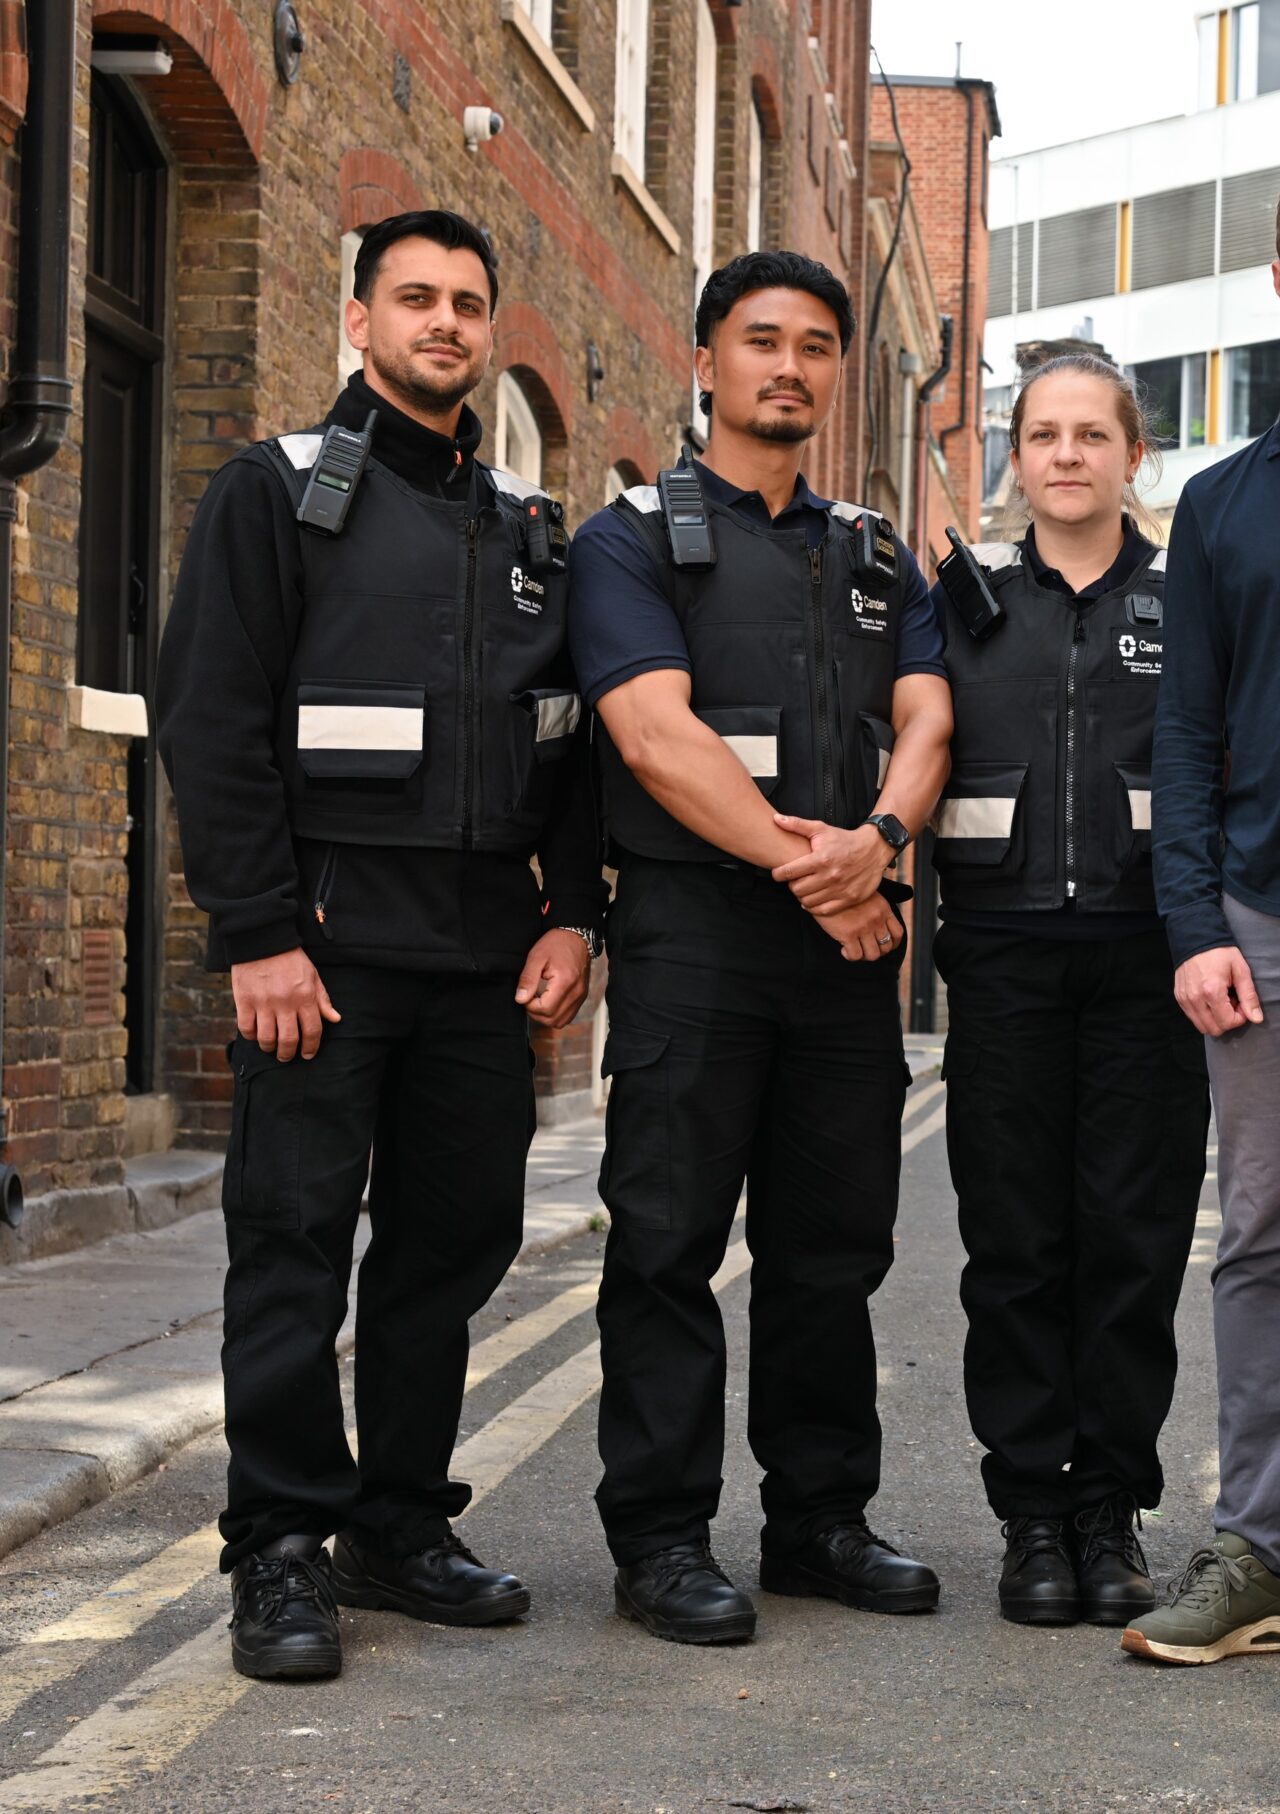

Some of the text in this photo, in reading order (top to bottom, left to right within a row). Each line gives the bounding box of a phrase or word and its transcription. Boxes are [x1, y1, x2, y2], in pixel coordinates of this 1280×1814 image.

[524, 575, 545, 595] Camden
[863, 595, 888, 611] Camden
[1122, 660, 1153, 669] Community
